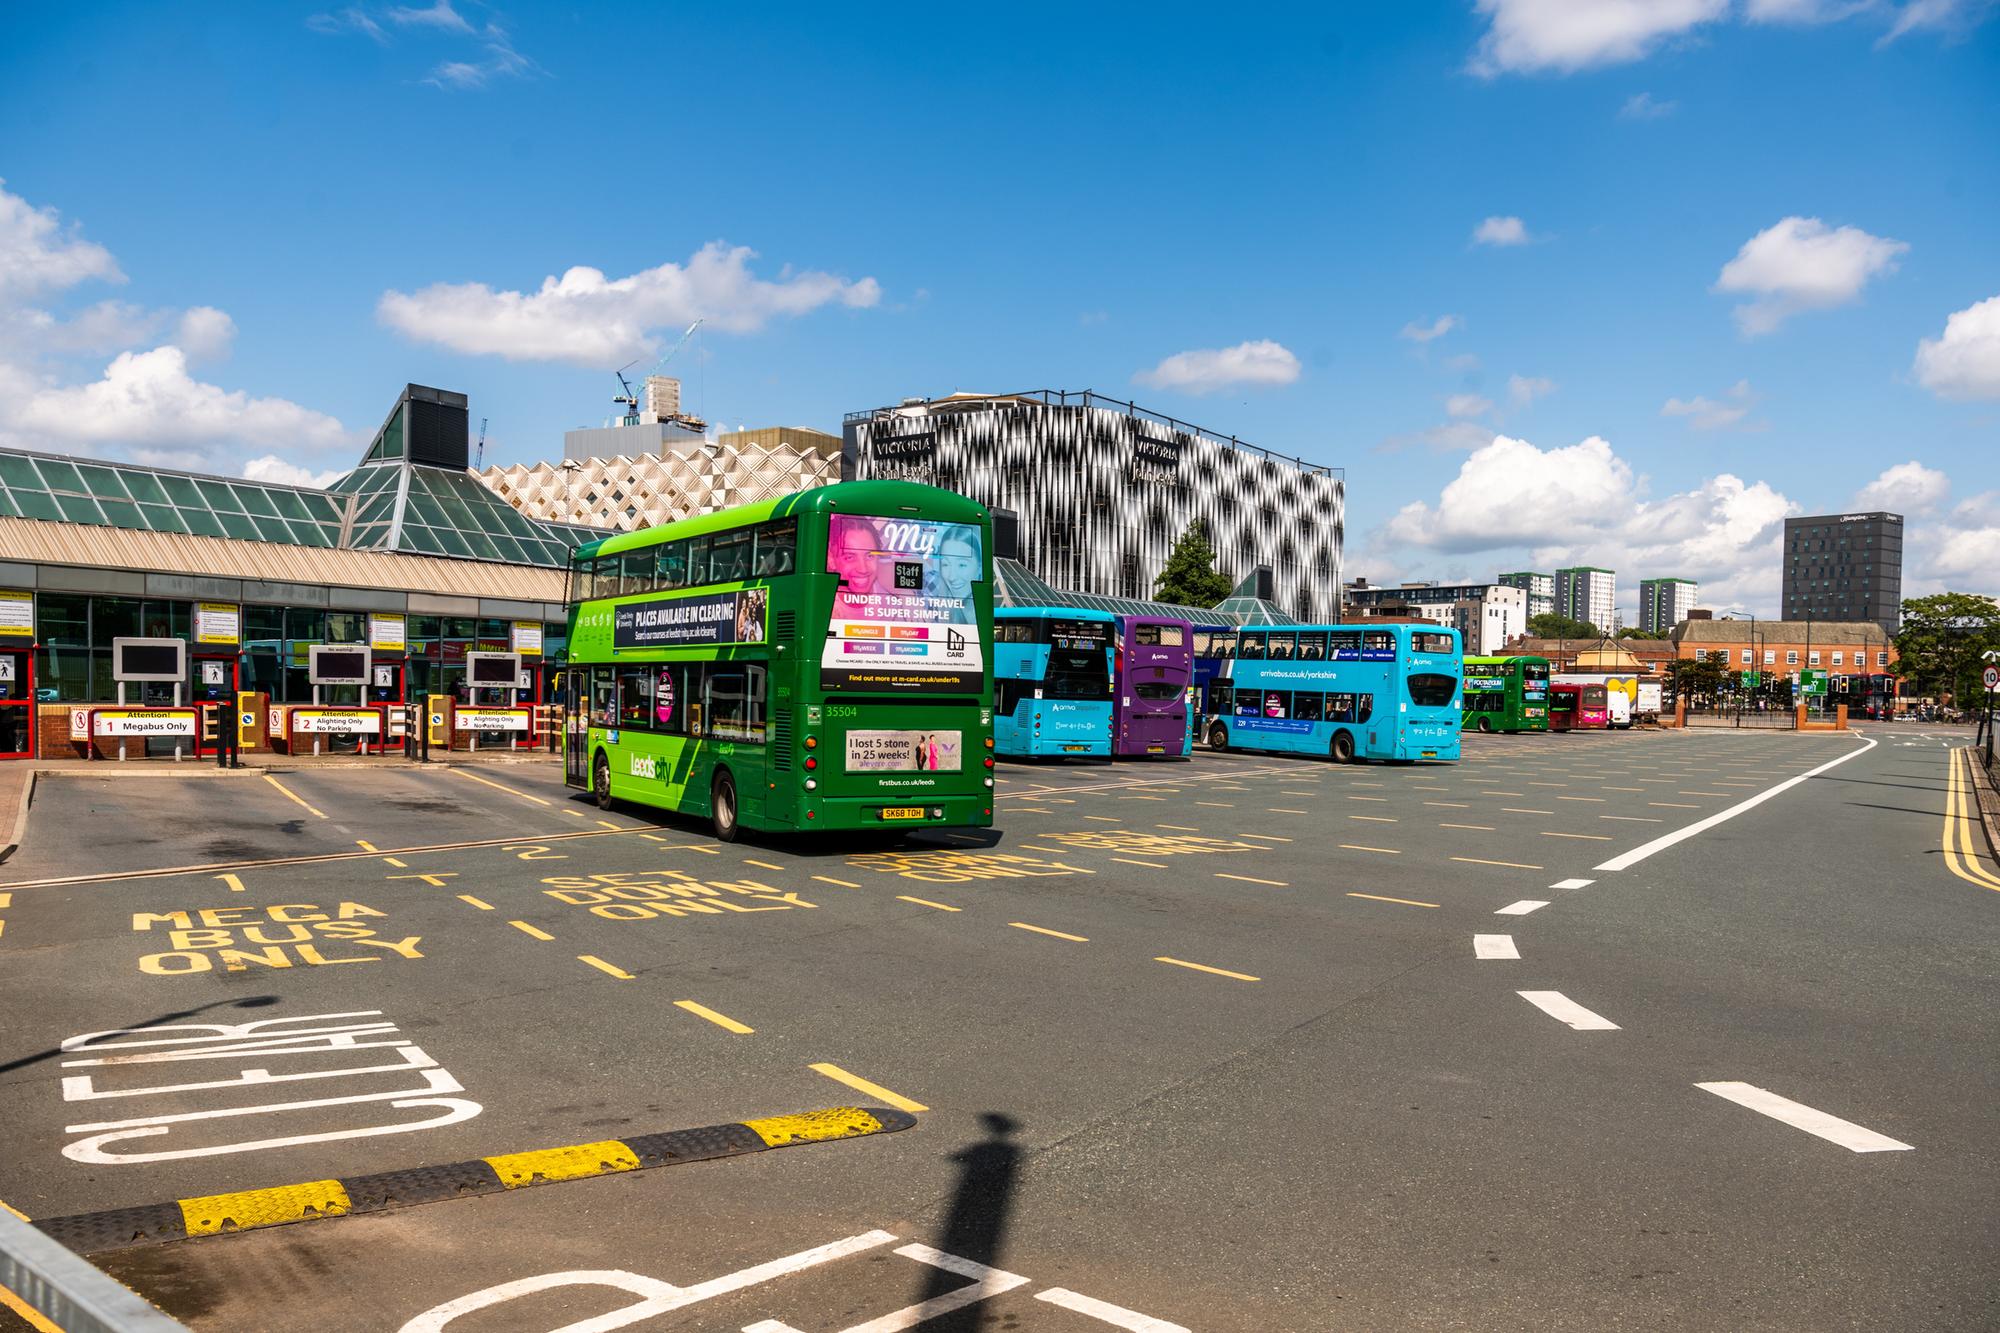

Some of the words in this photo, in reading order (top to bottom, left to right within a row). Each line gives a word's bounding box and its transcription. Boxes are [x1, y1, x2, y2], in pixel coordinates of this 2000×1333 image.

[877, 438, 930, 455] VICTORIA
[1137, 440, 1177, 460] VICTORIA
[1132, 461, 1151, 481] John
[884, 523, 935, 560] My
[896, 565, 919, 577] Staff
[900, 576, 916, 587] Bus
[844, 594, 881, 605] UNDER
[885, 597, 902, 606] 19s
[906, 597, 925, 607] BUS
[928, 599, 965, 609] TRAVEL
[636, 610, 657, 627] PLACES
[657, 607, 689, 626] AVAILABLE
[690, 606, 698, 623] IN
[699, 603, 734, 622] CLEARING
[864, 607, 874, 616] IS
[877, 608, 910, 619] SUPER
[914, 609, 950, 620] SIMPLE
[1260, 670, 1337, 680] arrivabus.co.uk/yorkshire
[1985, 672, 1996, 682] 10
[127, 711, 171, 719] Attention!
[827, 707, 857, 717] 35504
[107, 722, 113, 732] 1
[123, 722, 164, 733] Megabus
[166, 722, 188, 732] Only
[303, 720, 310, 729] 2
[462, 718, 468, 726] 3
[849, 739, 853, 748] I
[855, 739, 873, 748] lost
[876, 739, 882, 748] 5
[884, 739, 910, 748] stone
[851, 750, 860, 759] in
[863, 750, 875, 759] 25
[878, 750, 910, 759] weeks!
[879, 779, 935, 787] firstbus.co.uk/leeds
[886, 809, 905, 818] SK68
[844, 854, 1044, 872] DOWN
[540, 870, 699, 889] SET
[898, 862, 1096, 883] ONLY
[213, 873, 246, 891] 1
[542, 879, 782, 905] DOWN
[589, 892, 819, 920] ONLY
[133, 902, 388, 931] MEGA
[168, 921, 377, 950] BUS
[139, 936, 425, 975] ONLY
